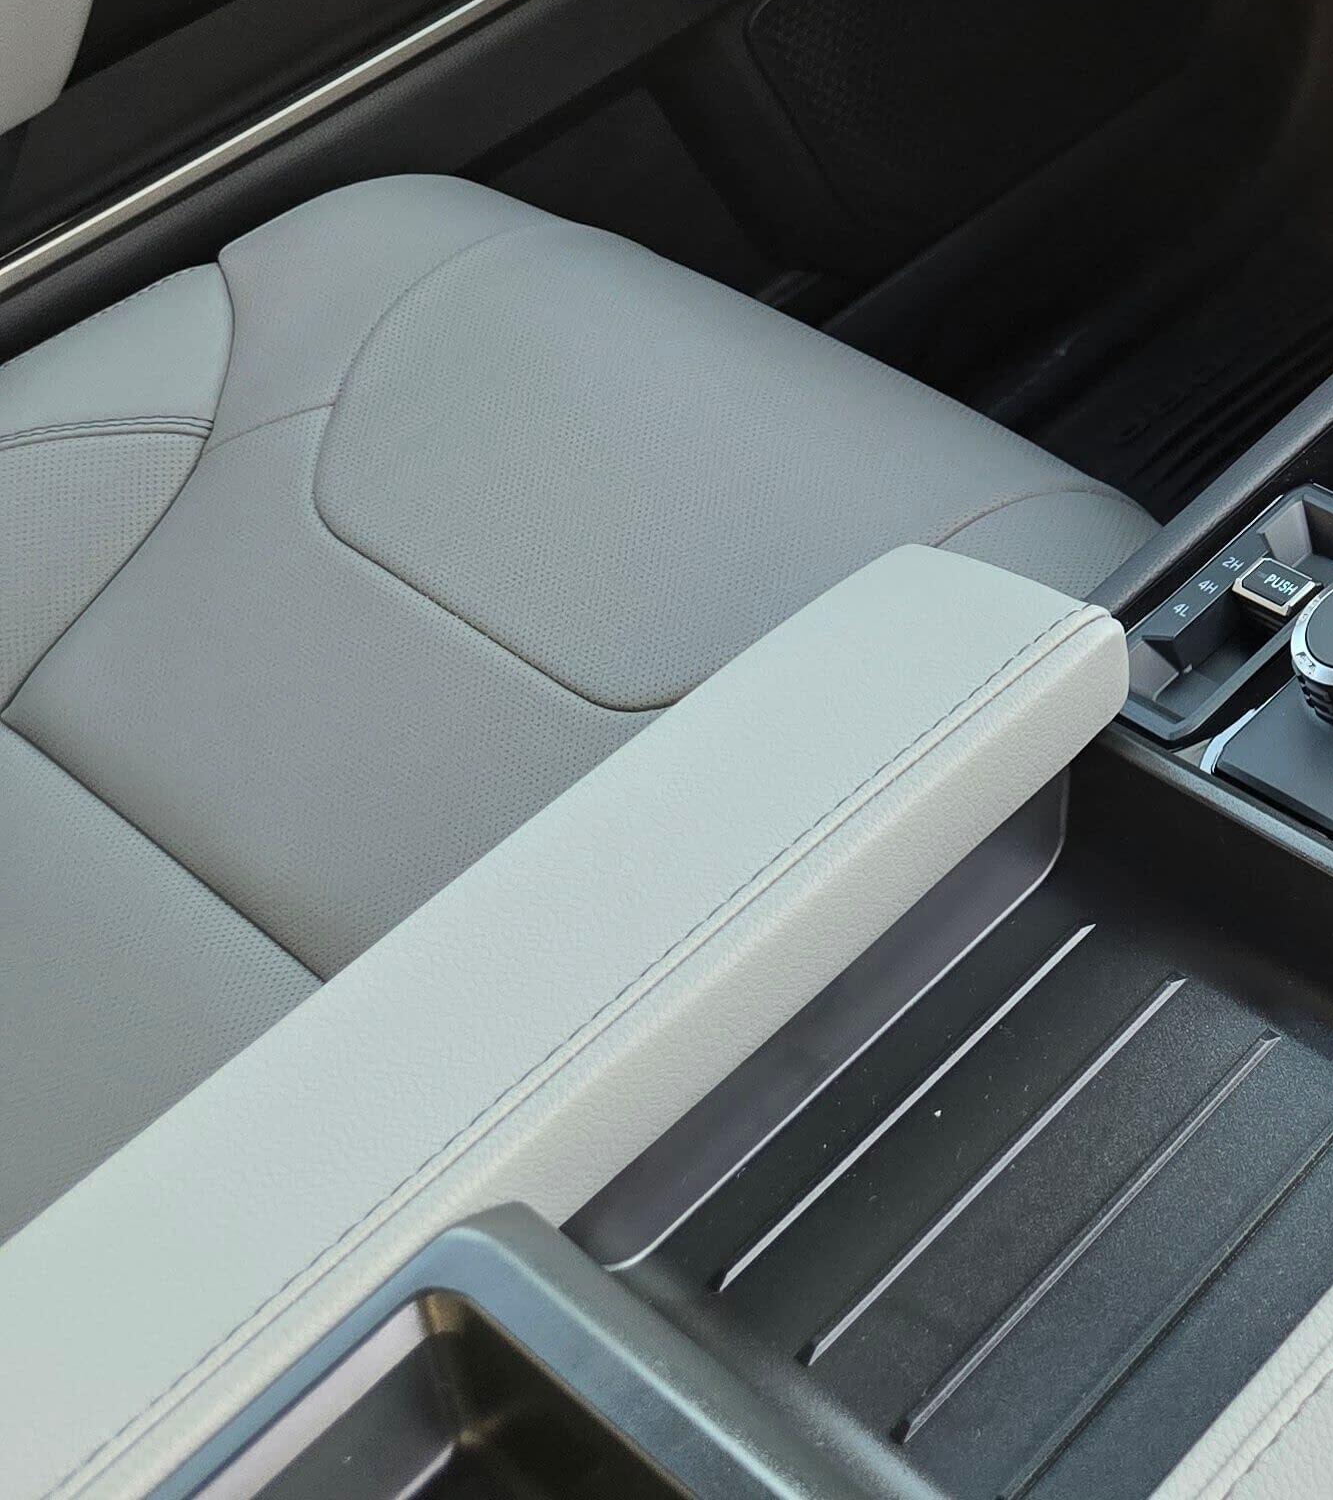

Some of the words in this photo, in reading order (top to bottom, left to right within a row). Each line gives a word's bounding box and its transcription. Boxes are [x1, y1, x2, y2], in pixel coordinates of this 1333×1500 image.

[1222, 555, 1244, 573] 2H
[1197, 579, 1219, 596] 4H
[1264, 573, 1298, 596] PUSH
[1173, 602, 1189, 618] 4L
